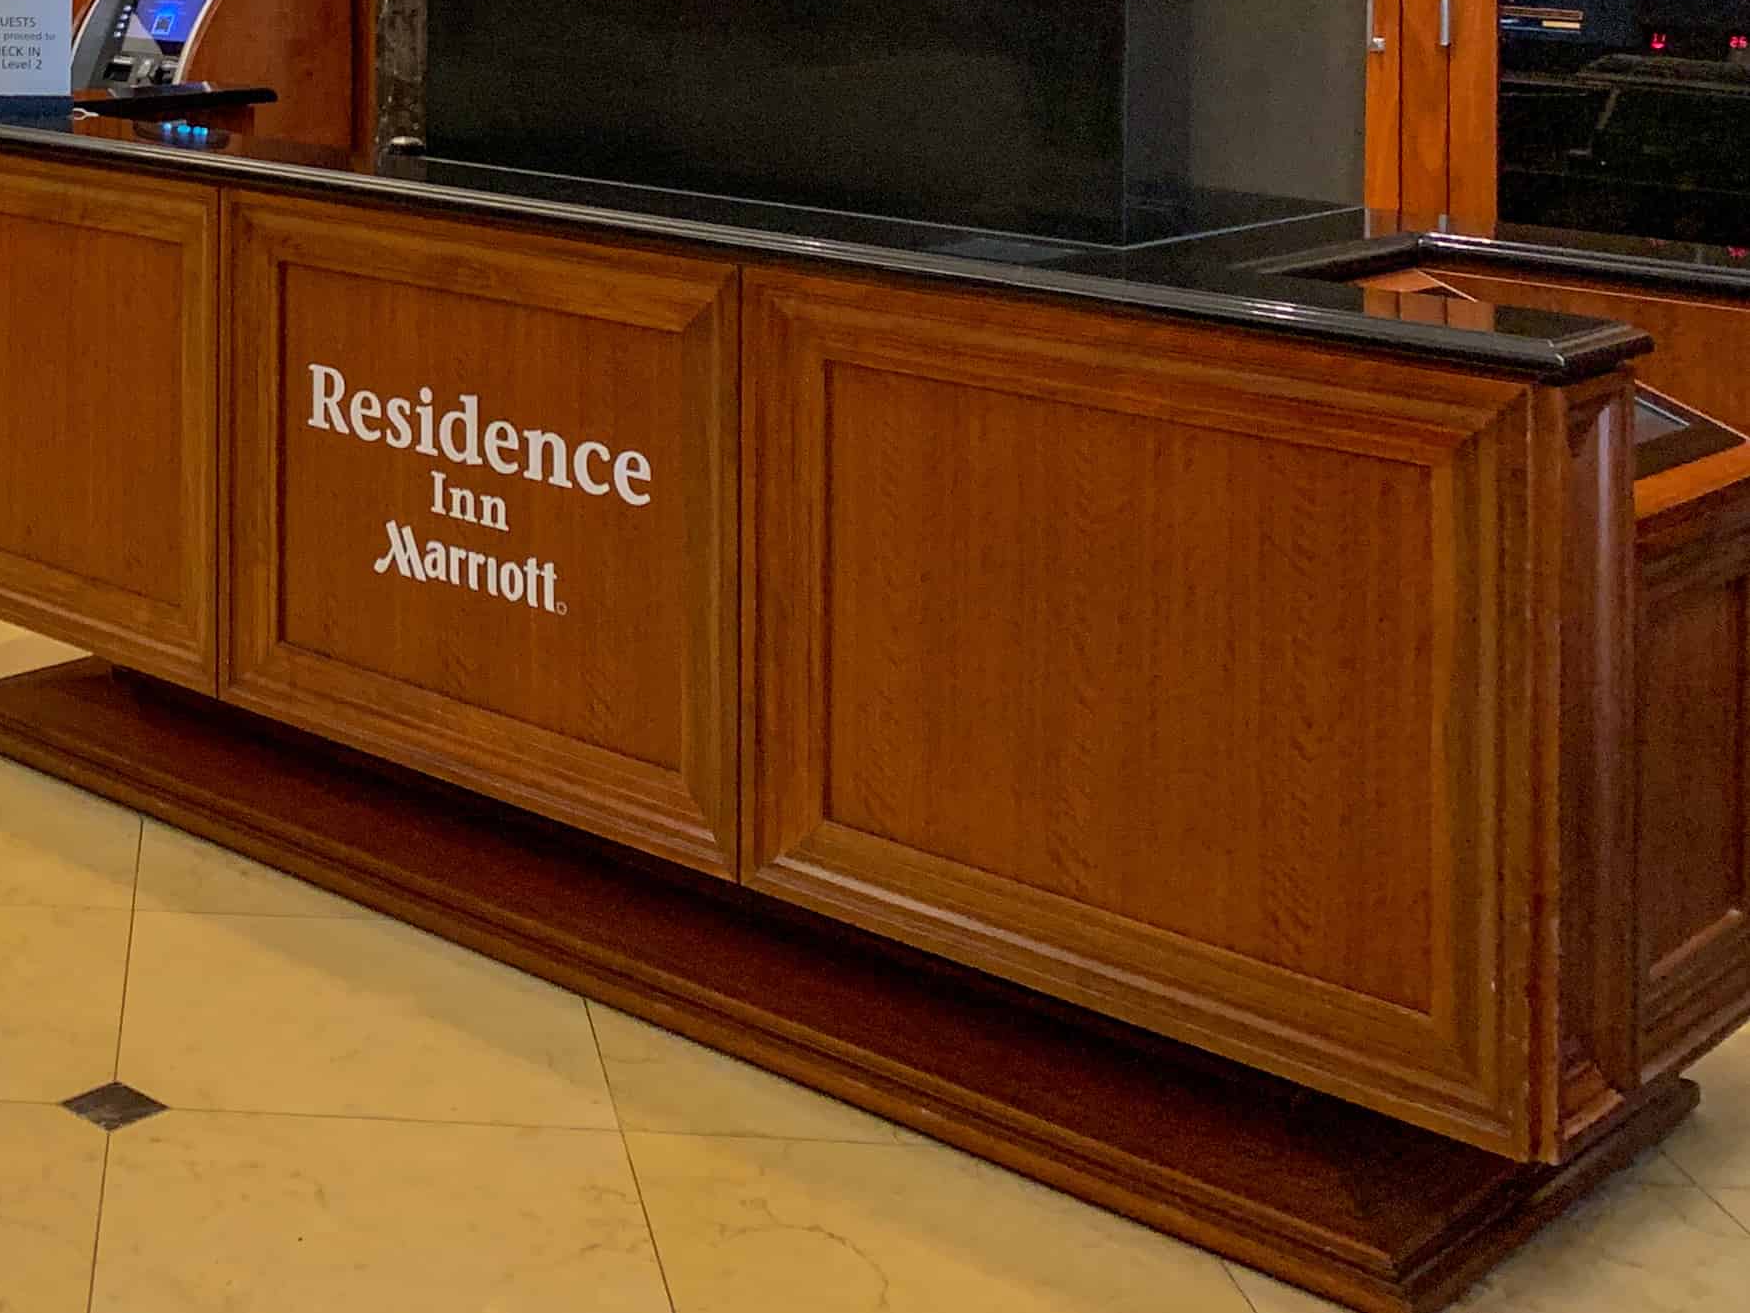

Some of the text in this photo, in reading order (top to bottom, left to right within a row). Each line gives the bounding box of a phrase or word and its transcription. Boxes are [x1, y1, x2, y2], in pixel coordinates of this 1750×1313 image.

[1, 59, 32, 70] Level
[35, 59, 43, 70] 2
[28, 46, 41, 57] IN
[307, 363, 651, 506] Residence
[430, 470, 509, 531] Inn
[373, 520, 558, 613] Marriott
